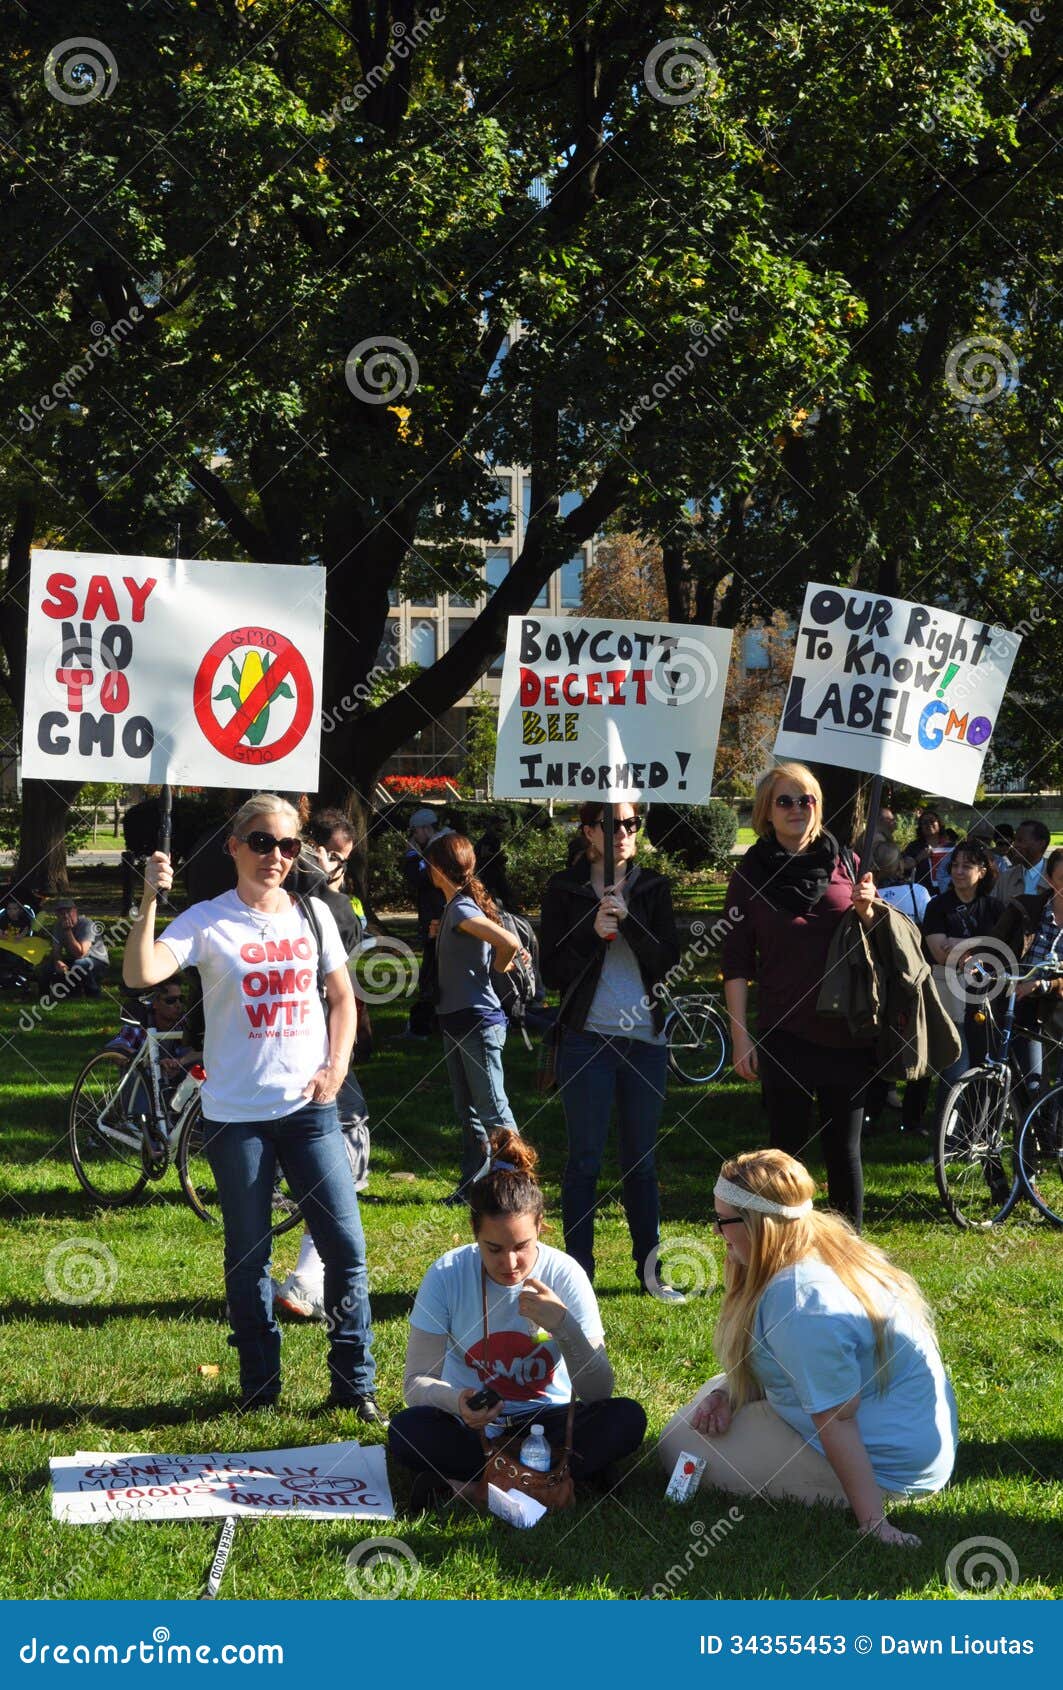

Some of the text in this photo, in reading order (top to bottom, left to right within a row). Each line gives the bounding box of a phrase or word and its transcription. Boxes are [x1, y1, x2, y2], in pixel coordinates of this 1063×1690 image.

[41, 572, 157, 623] SAY
[61, 622, 133, 670] NO
[520, 619, 680, 666] BOYCOTT
[810, 590, 992, 670] OUR Right
[801, 627, 960, 698] To Know!
[56, 668, 130, 714] TO
[522, 710, 579, 745] BEE
[783, 676, 992, 750] LABEL GMO
[38, 711, 155, 759] GMO
[520, 751, 691, 790] INFORMED!
[240, 937, 312, 964] GMO
[242, 968, 312, 998] OMG
[245, 1000, 312, 1028] WTF
[265, 1029, 281, 1039] We
[473, 1356, 547, 1386] MO
[76, 1458, 132, 1468] AY
[231, 1492, 382, 1507] ORGANIC
